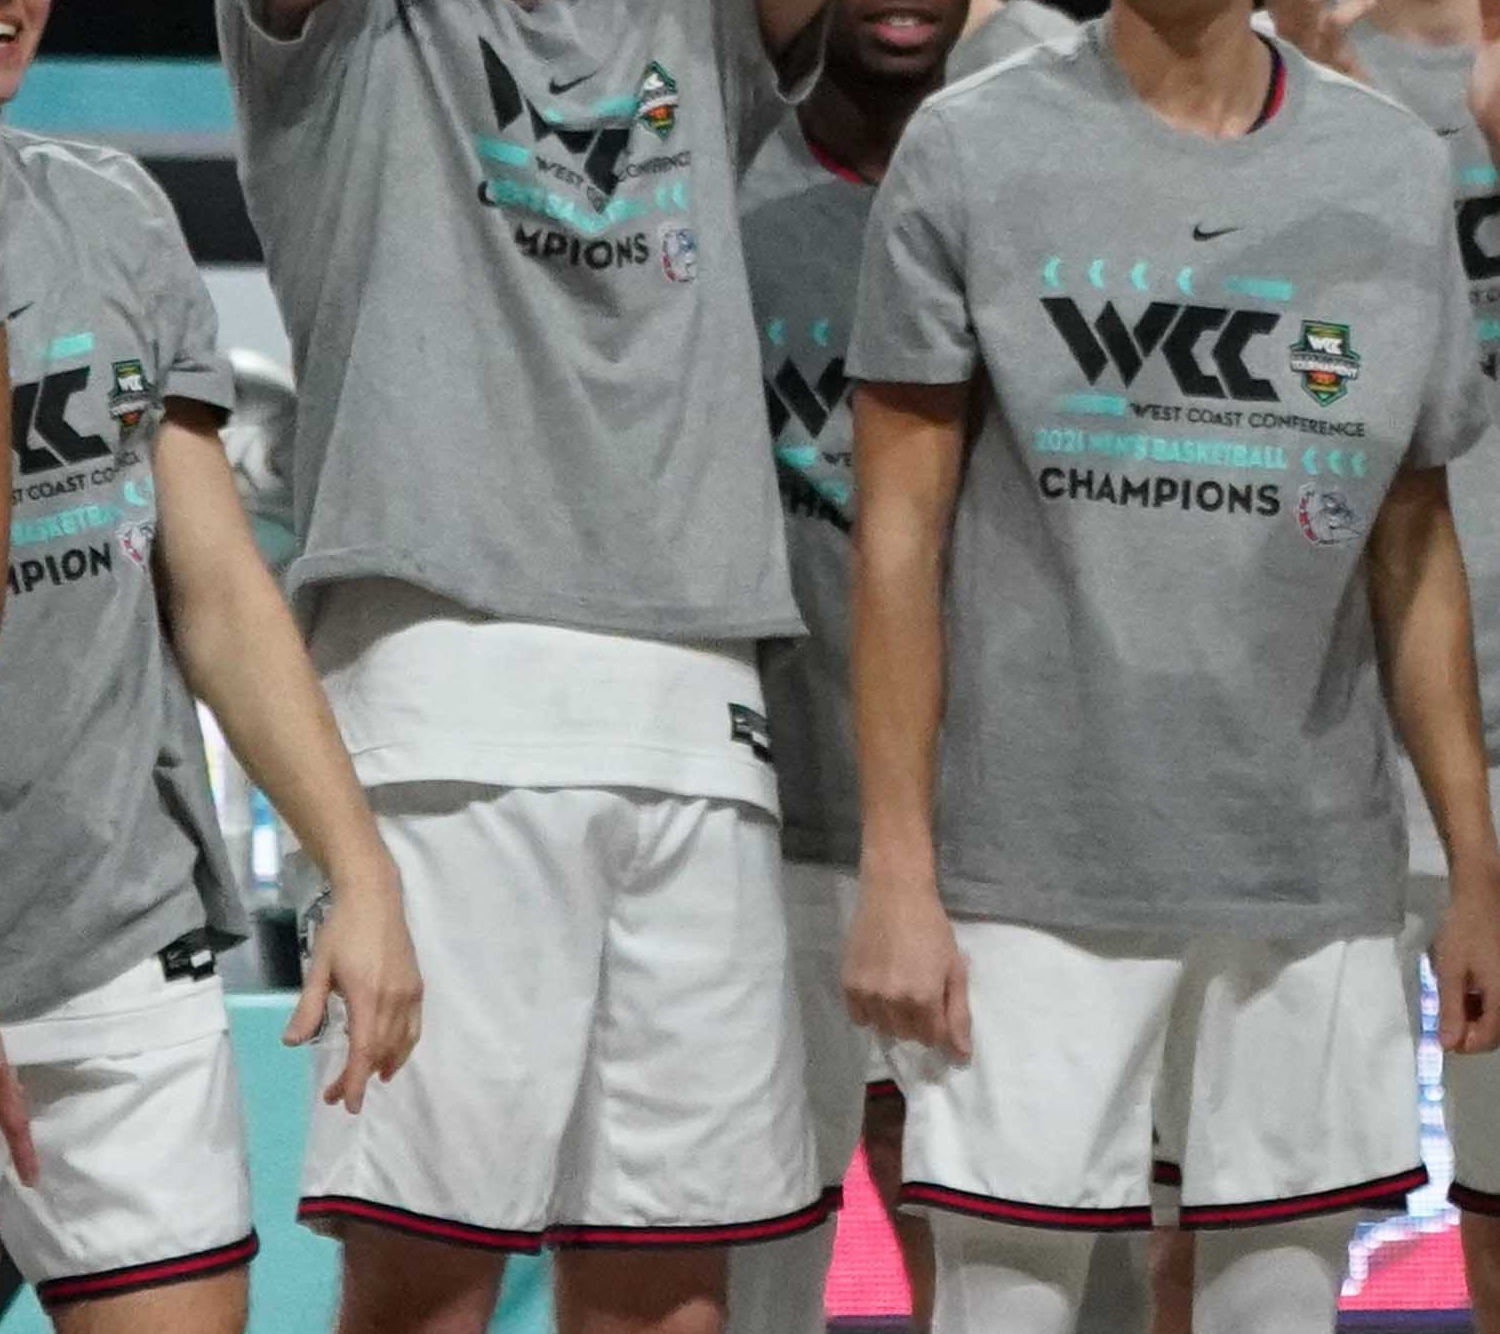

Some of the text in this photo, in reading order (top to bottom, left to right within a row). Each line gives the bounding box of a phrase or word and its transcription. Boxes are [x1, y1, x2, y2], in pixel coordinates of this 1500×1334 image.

[1039, 297, 1283, 402] WCC
[1130, 401, 1366, 438] WEST COAST CONFERENCE
[1039, 466, 1281, 517] CHAMPIONS
